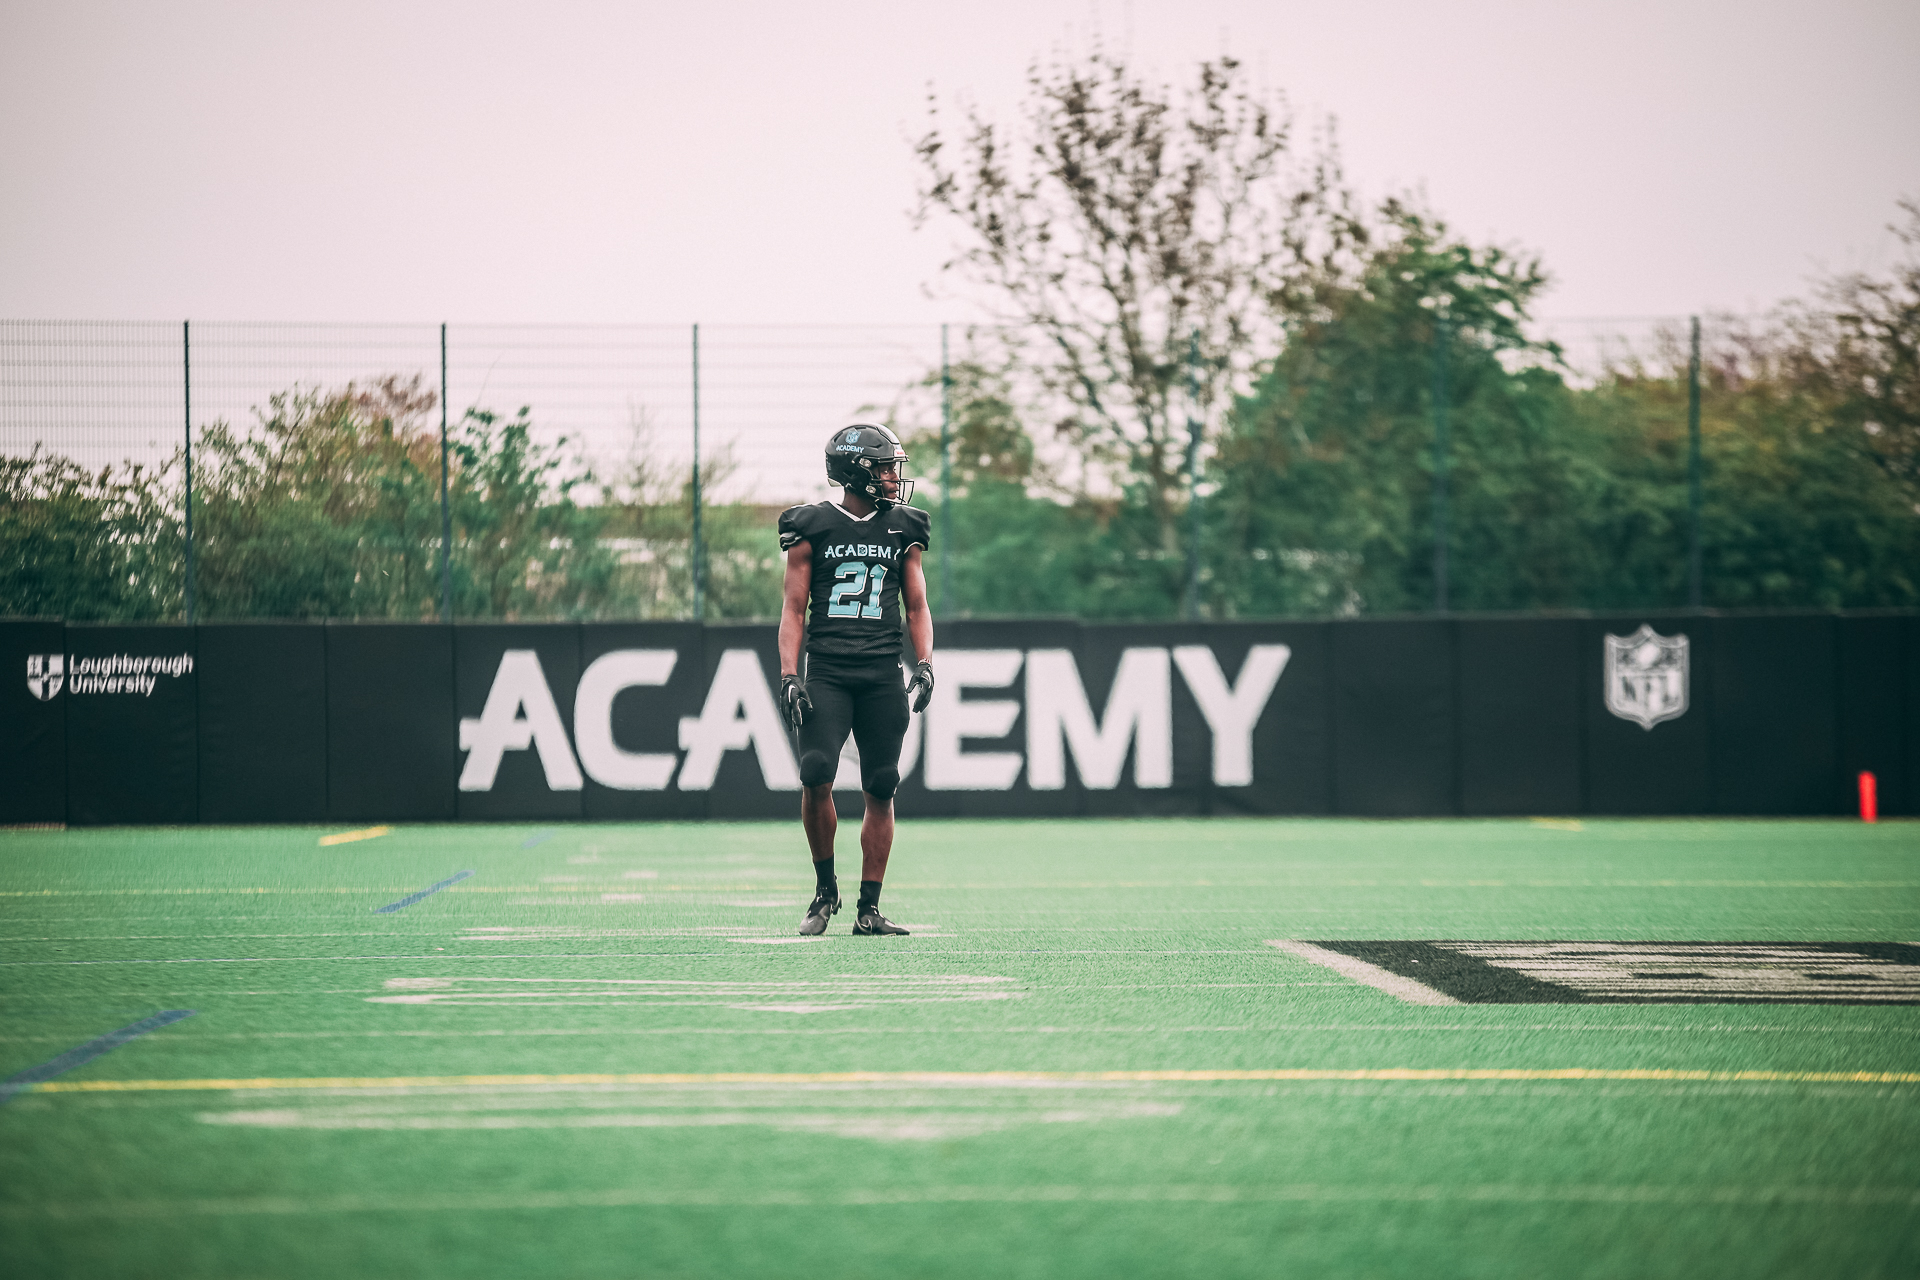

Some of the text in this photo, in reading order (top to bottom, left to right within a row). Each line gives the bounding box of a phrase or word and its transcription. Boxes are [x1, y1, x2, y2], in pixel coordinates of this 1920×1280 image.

[835, 444, 865, 454] ACADEMY
[827, 561, 888, 620] 21
[69, 652, 194, 678] Loughborough
[69, 675, 156, 697] University
[457, 643, 1292, 792] ACAEMY
